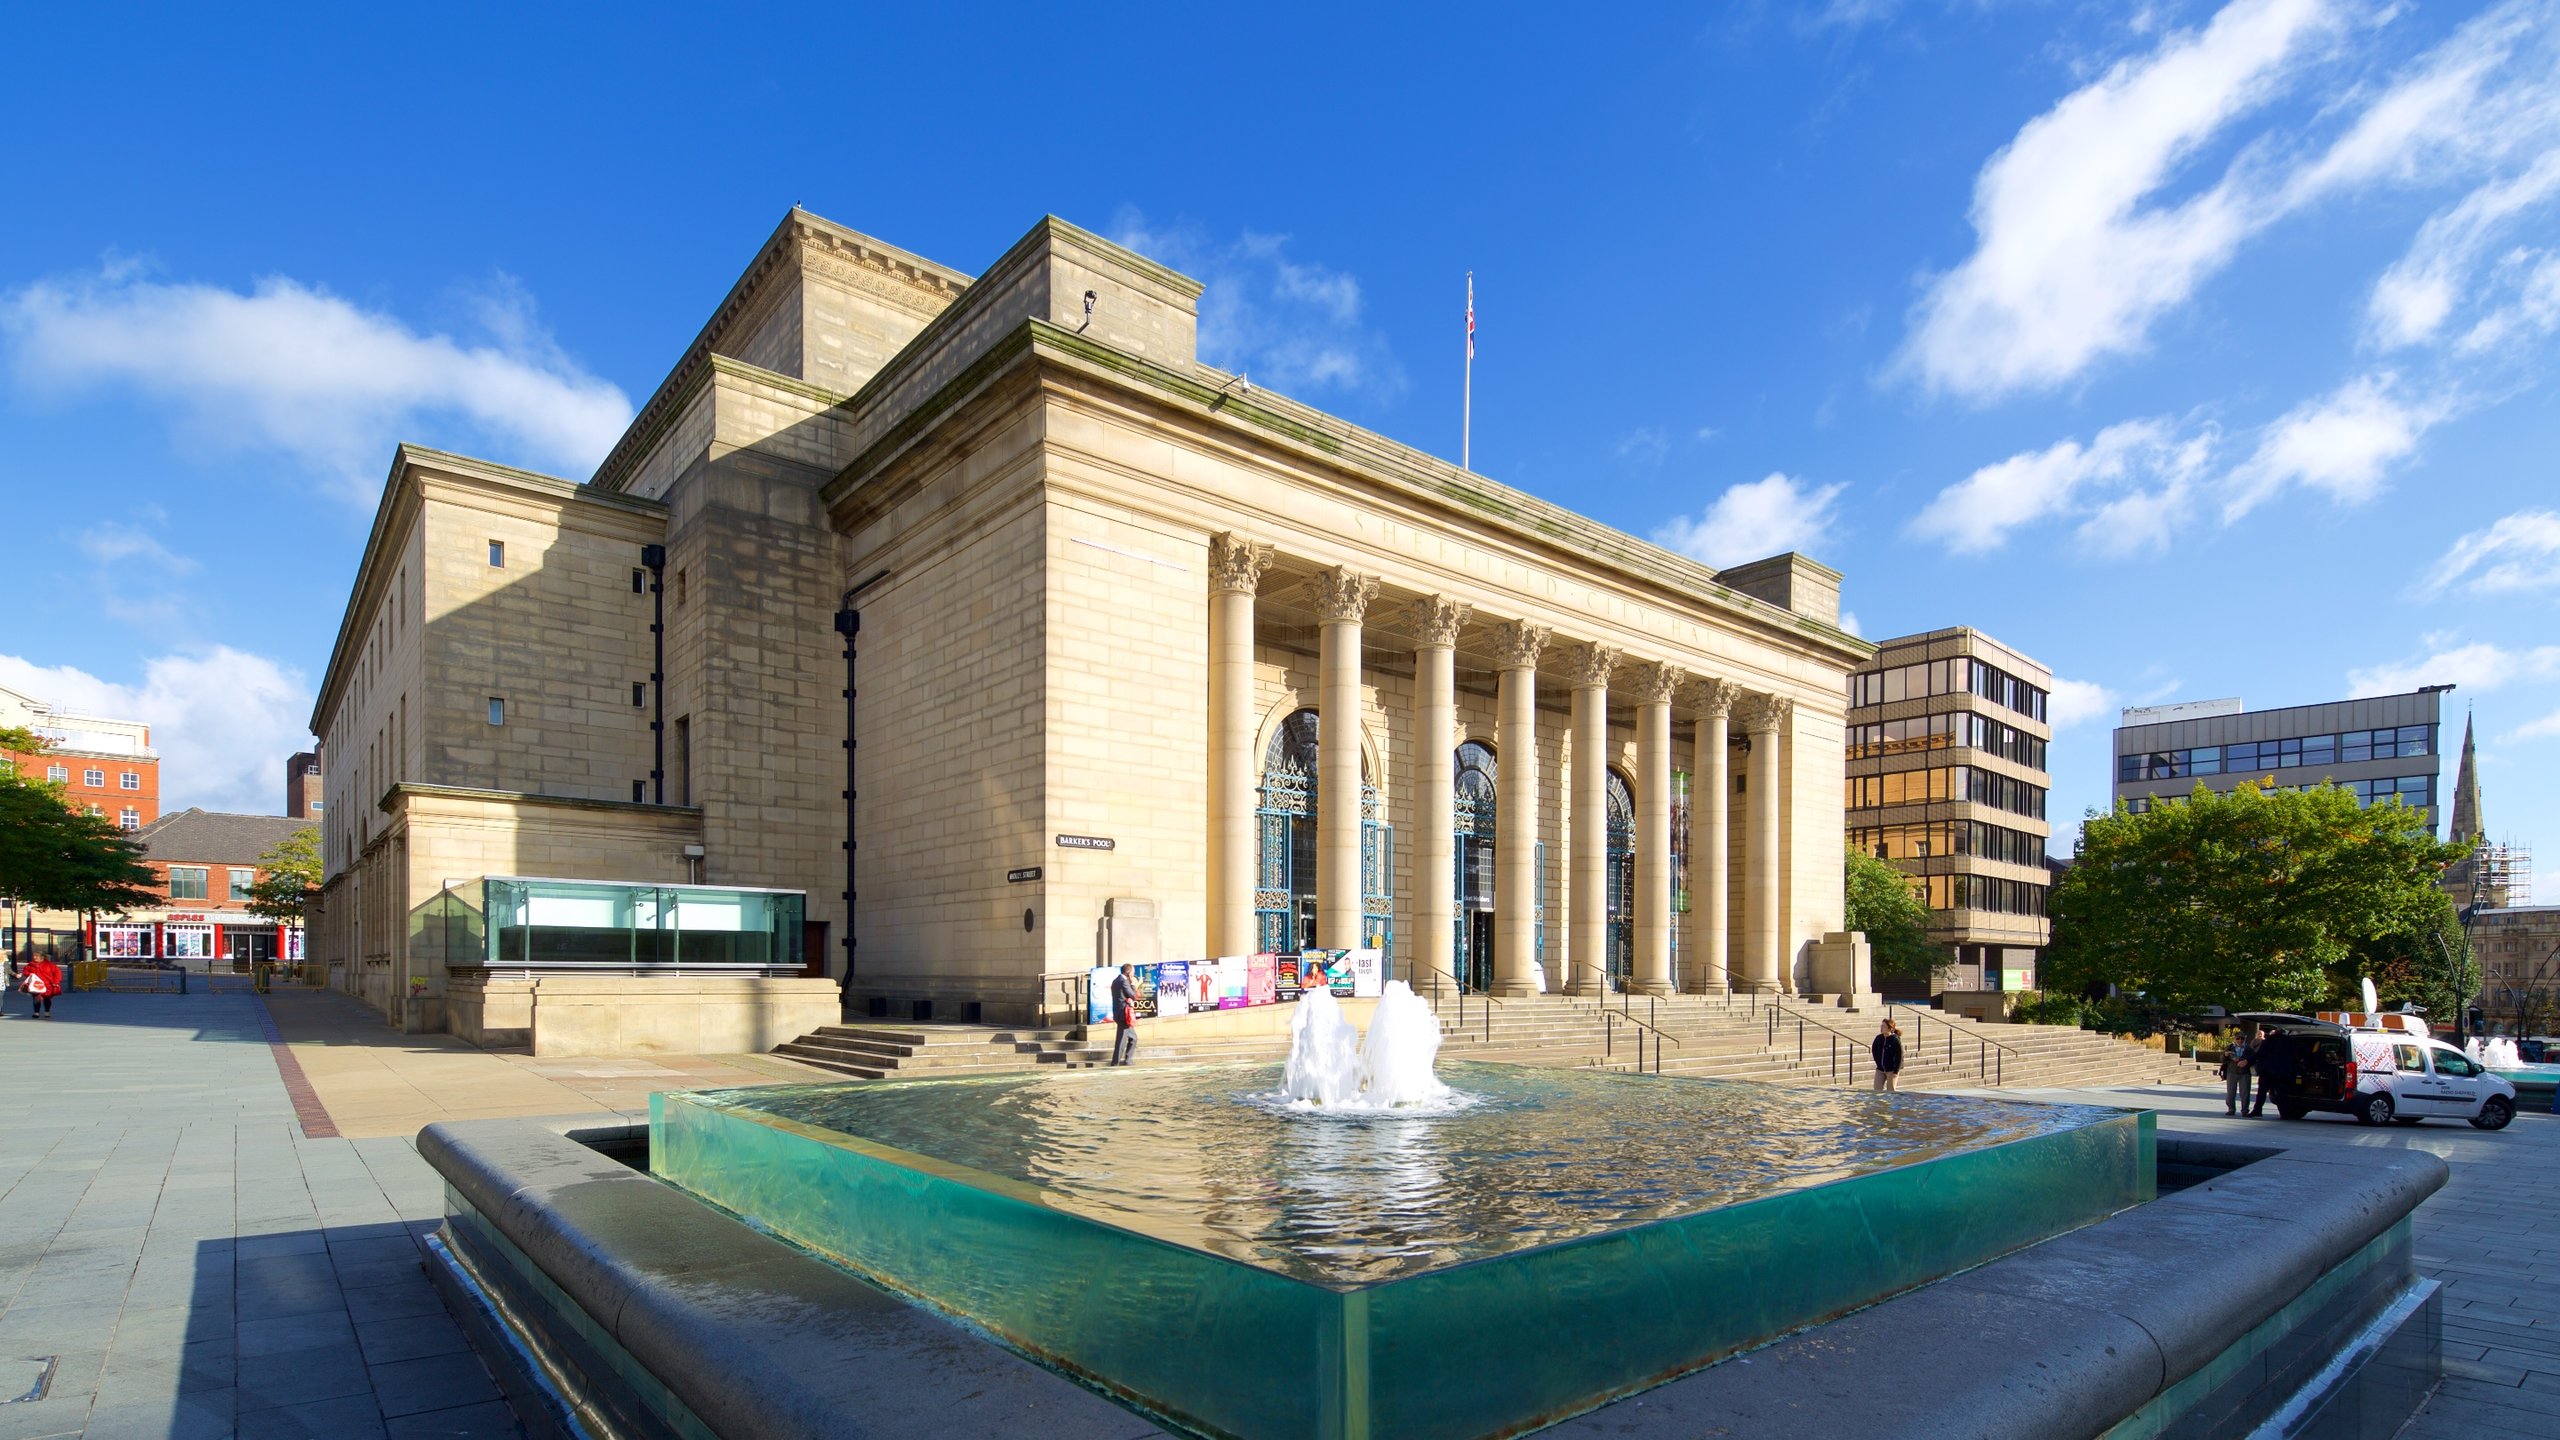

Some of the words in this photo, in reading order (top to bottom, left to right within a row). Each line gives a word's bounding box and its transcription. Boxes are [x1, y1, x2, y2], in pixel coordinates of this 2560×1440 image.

[1060, 837, 1090, 846] BARKER'S
[1092, 839, 1111, 848] POOL
[1358, 958, 1372, 968] last
